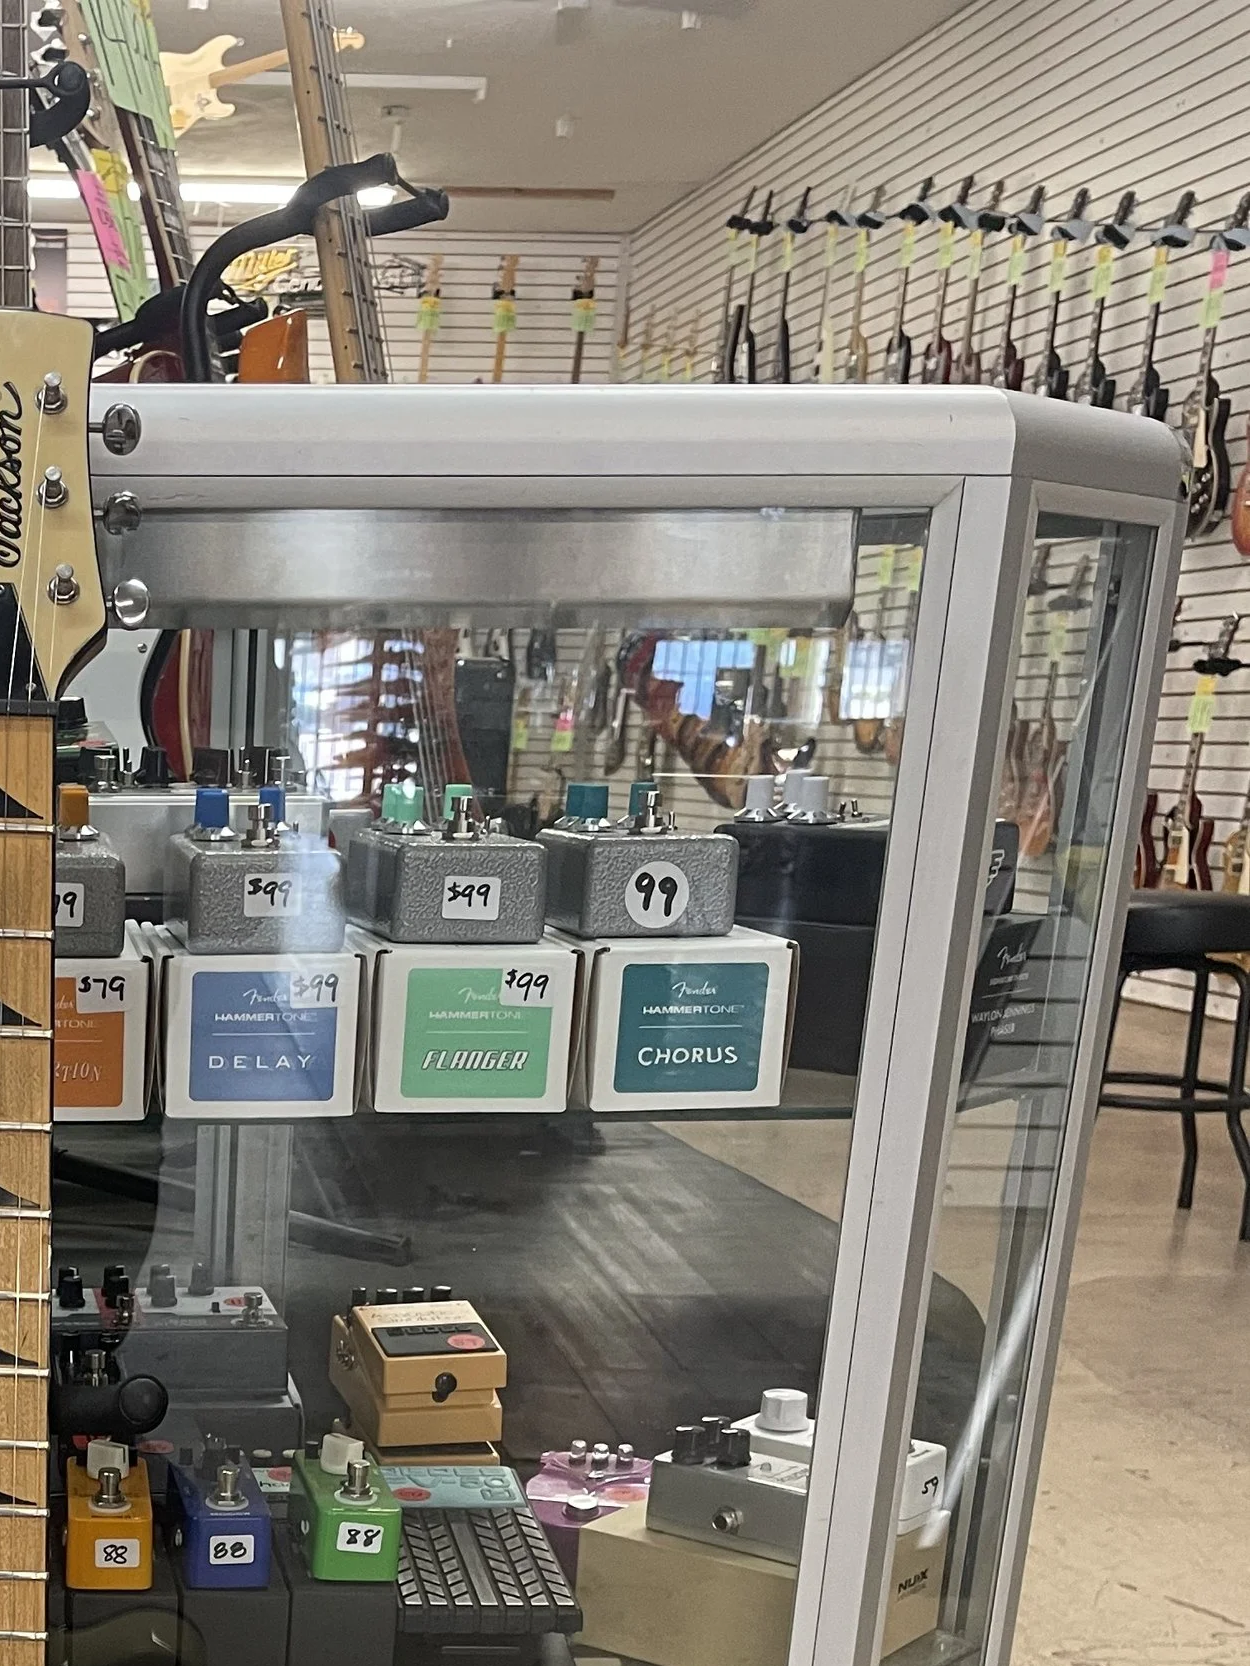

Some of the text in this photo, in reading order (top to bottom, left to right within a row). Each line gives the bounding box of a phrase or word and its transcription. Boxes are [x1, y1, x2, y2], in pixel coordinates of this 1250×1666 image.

[447, 882, 491, 908] $99
[635, 872, 678, 917] 99
[293, 973, 339, 1002] $99
[505, 968, 550, 1002] $99
[671, 981, 717, 999] Fender
[214, 1012, 313, 1022] HAMMERTONE
[642, 1004, 740, 1015] HAMMERTONE
[208, 1054, 313, 1069] DELAY
[421, 1050, 529, 1071] FLANGER
[637, 1045, 738, 1067] CHORUS
[921, 1475, 939, 1498] 59
[346, 1528, 381, 1547] 88
[102, 1544, 128, 1565] 88
[212, 1542, 248, 1559] 88
